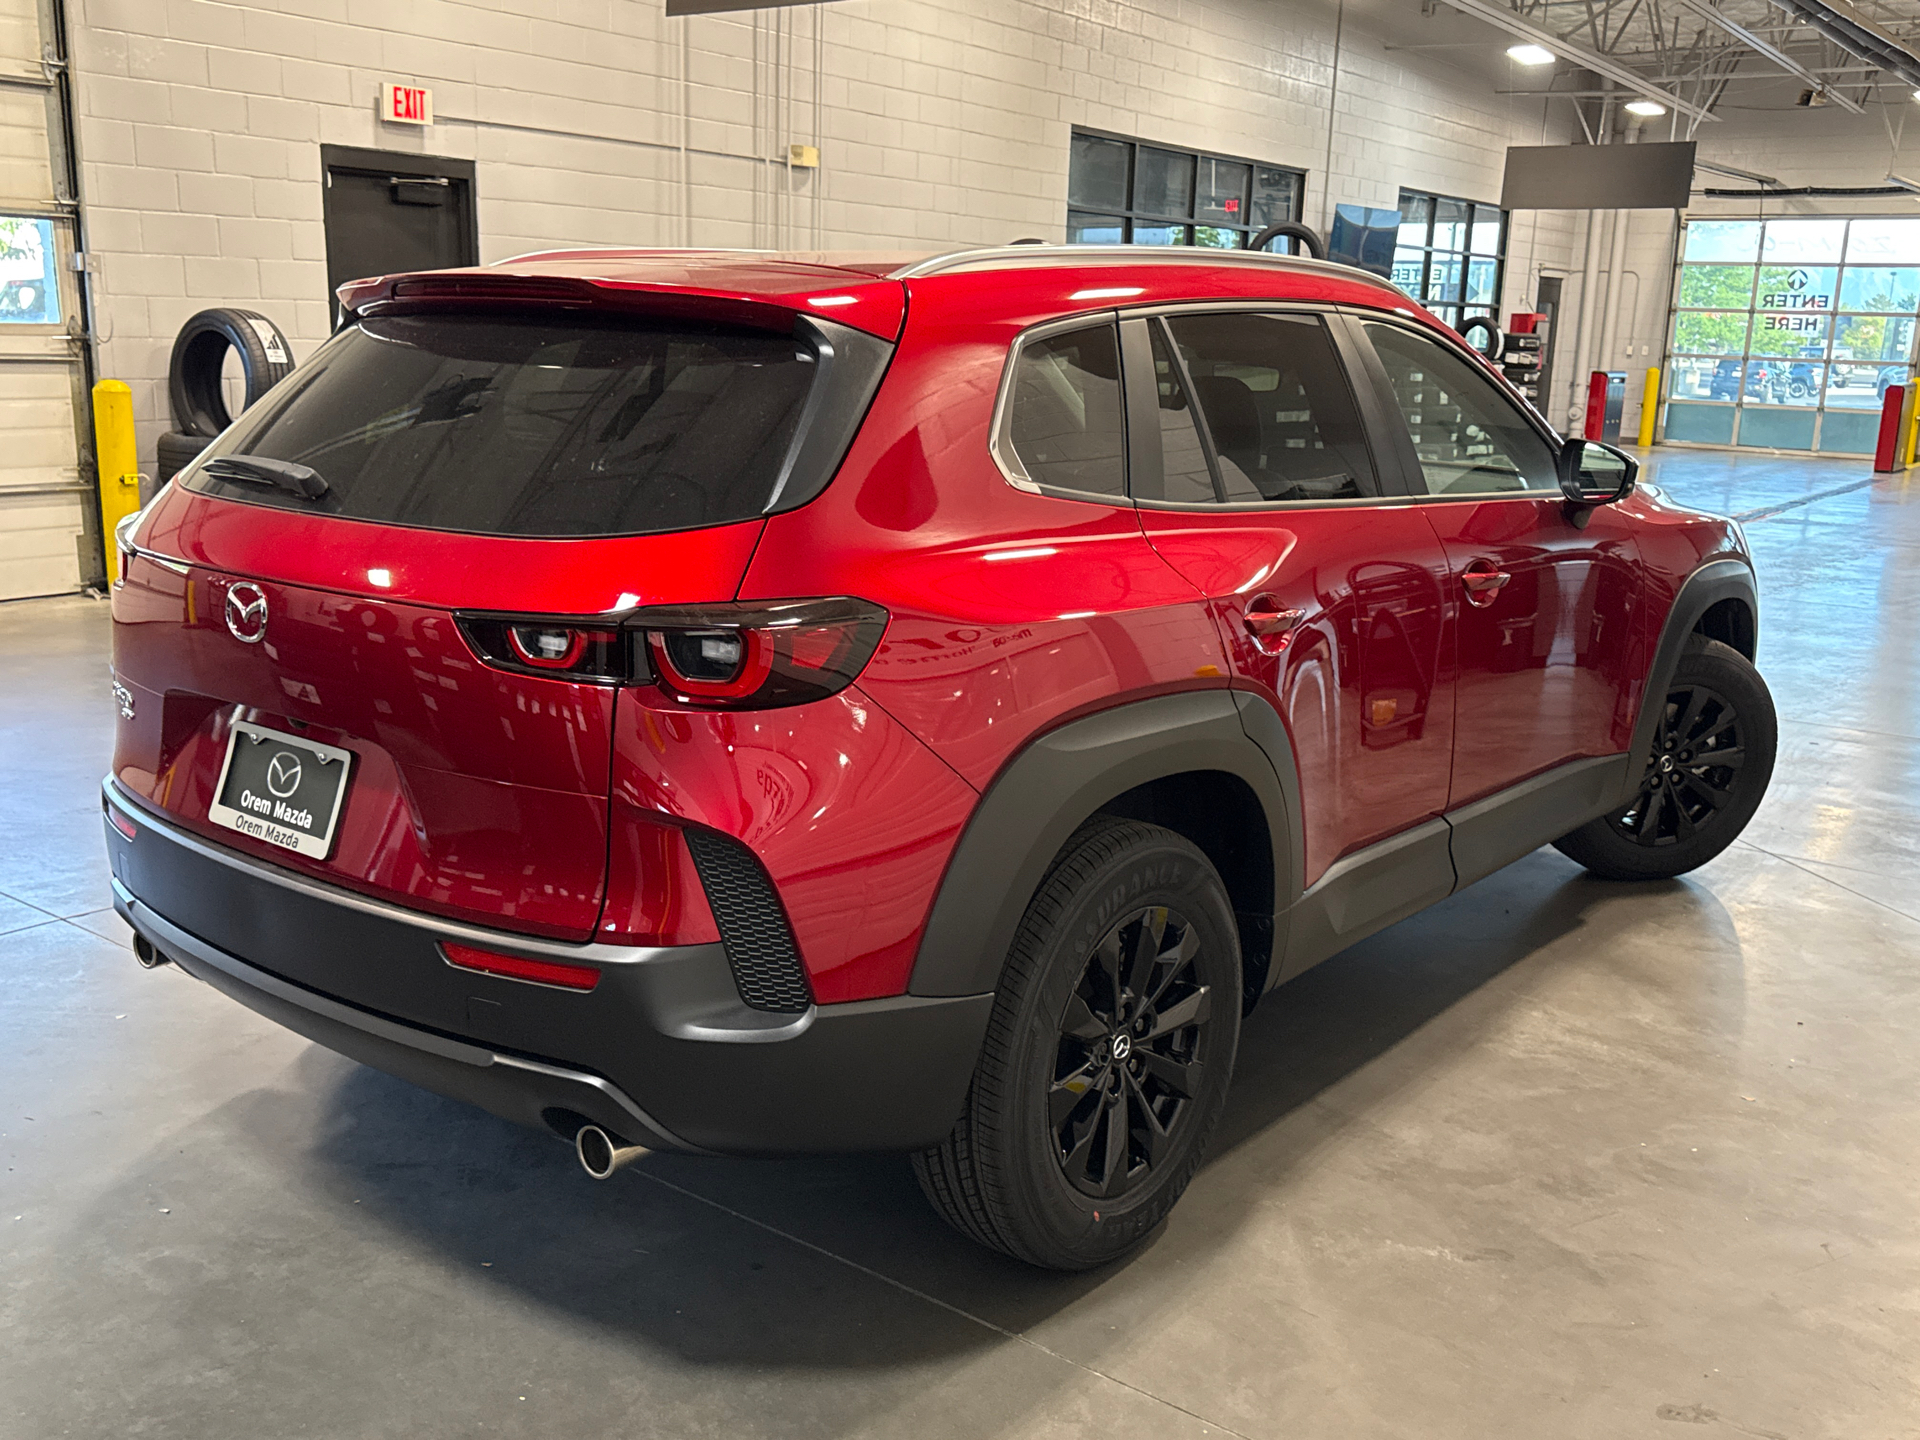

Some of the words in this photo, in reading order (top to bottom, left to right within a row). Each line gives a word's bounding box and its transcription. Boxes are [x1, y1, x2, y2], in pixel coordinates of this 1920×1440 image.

[393, 86, 426, 120] EXIT
[240, 789, 271, 815] Orem
[273, 800, 313, 829] Mazda
[235, 815, 263, 836] Orem
[264, 825, 299, 848] Mazda
